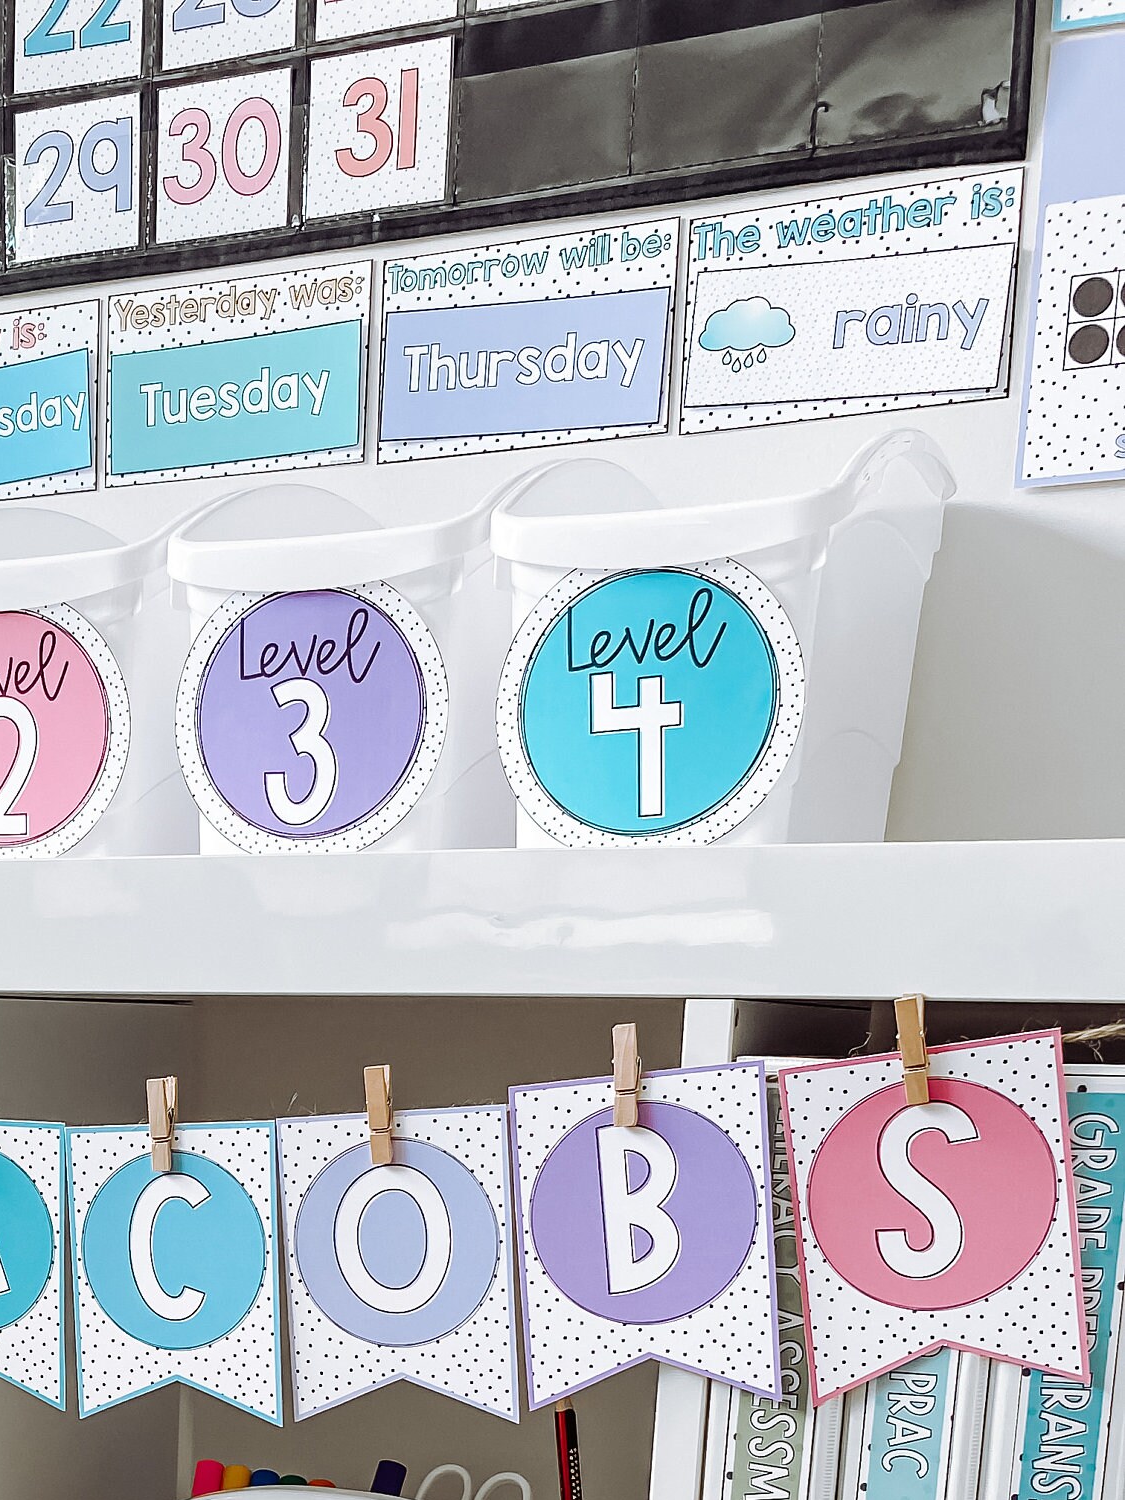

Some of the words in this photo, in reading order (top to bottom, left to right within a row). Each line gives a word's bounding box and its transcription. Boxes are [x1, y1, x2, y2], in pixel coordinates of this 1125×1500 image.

[22, 116, 133, 228] 29
[162, 96, 282, 205] 30
[334, 67, 420, 178] 31
[692, 221, 762, 262] The
[775, 192, 958, 249] weather
[970, 183, 1016, 220] is:
[386, 248, 549, 297] Tomorrow
[560, 233, 611, 271] will
[620, 229, 673, 263] be:
[11, 319, 47, 352] is:
[113, 285, 277, 332] Yesterday
[289, 274, 365, 307] was:
[832, 292, 991, 352] rainy
[139, 367, 331, 428] Tuesday
[402, 333, 646, 393] Thursday
[238, 607, 382, 683] Level
[565, 587, 727, 673] Level
[263, 676, 338, 826] 3
[588, 671, 684, 818] 4
[880, 1370, 939, 1480] PRAC
